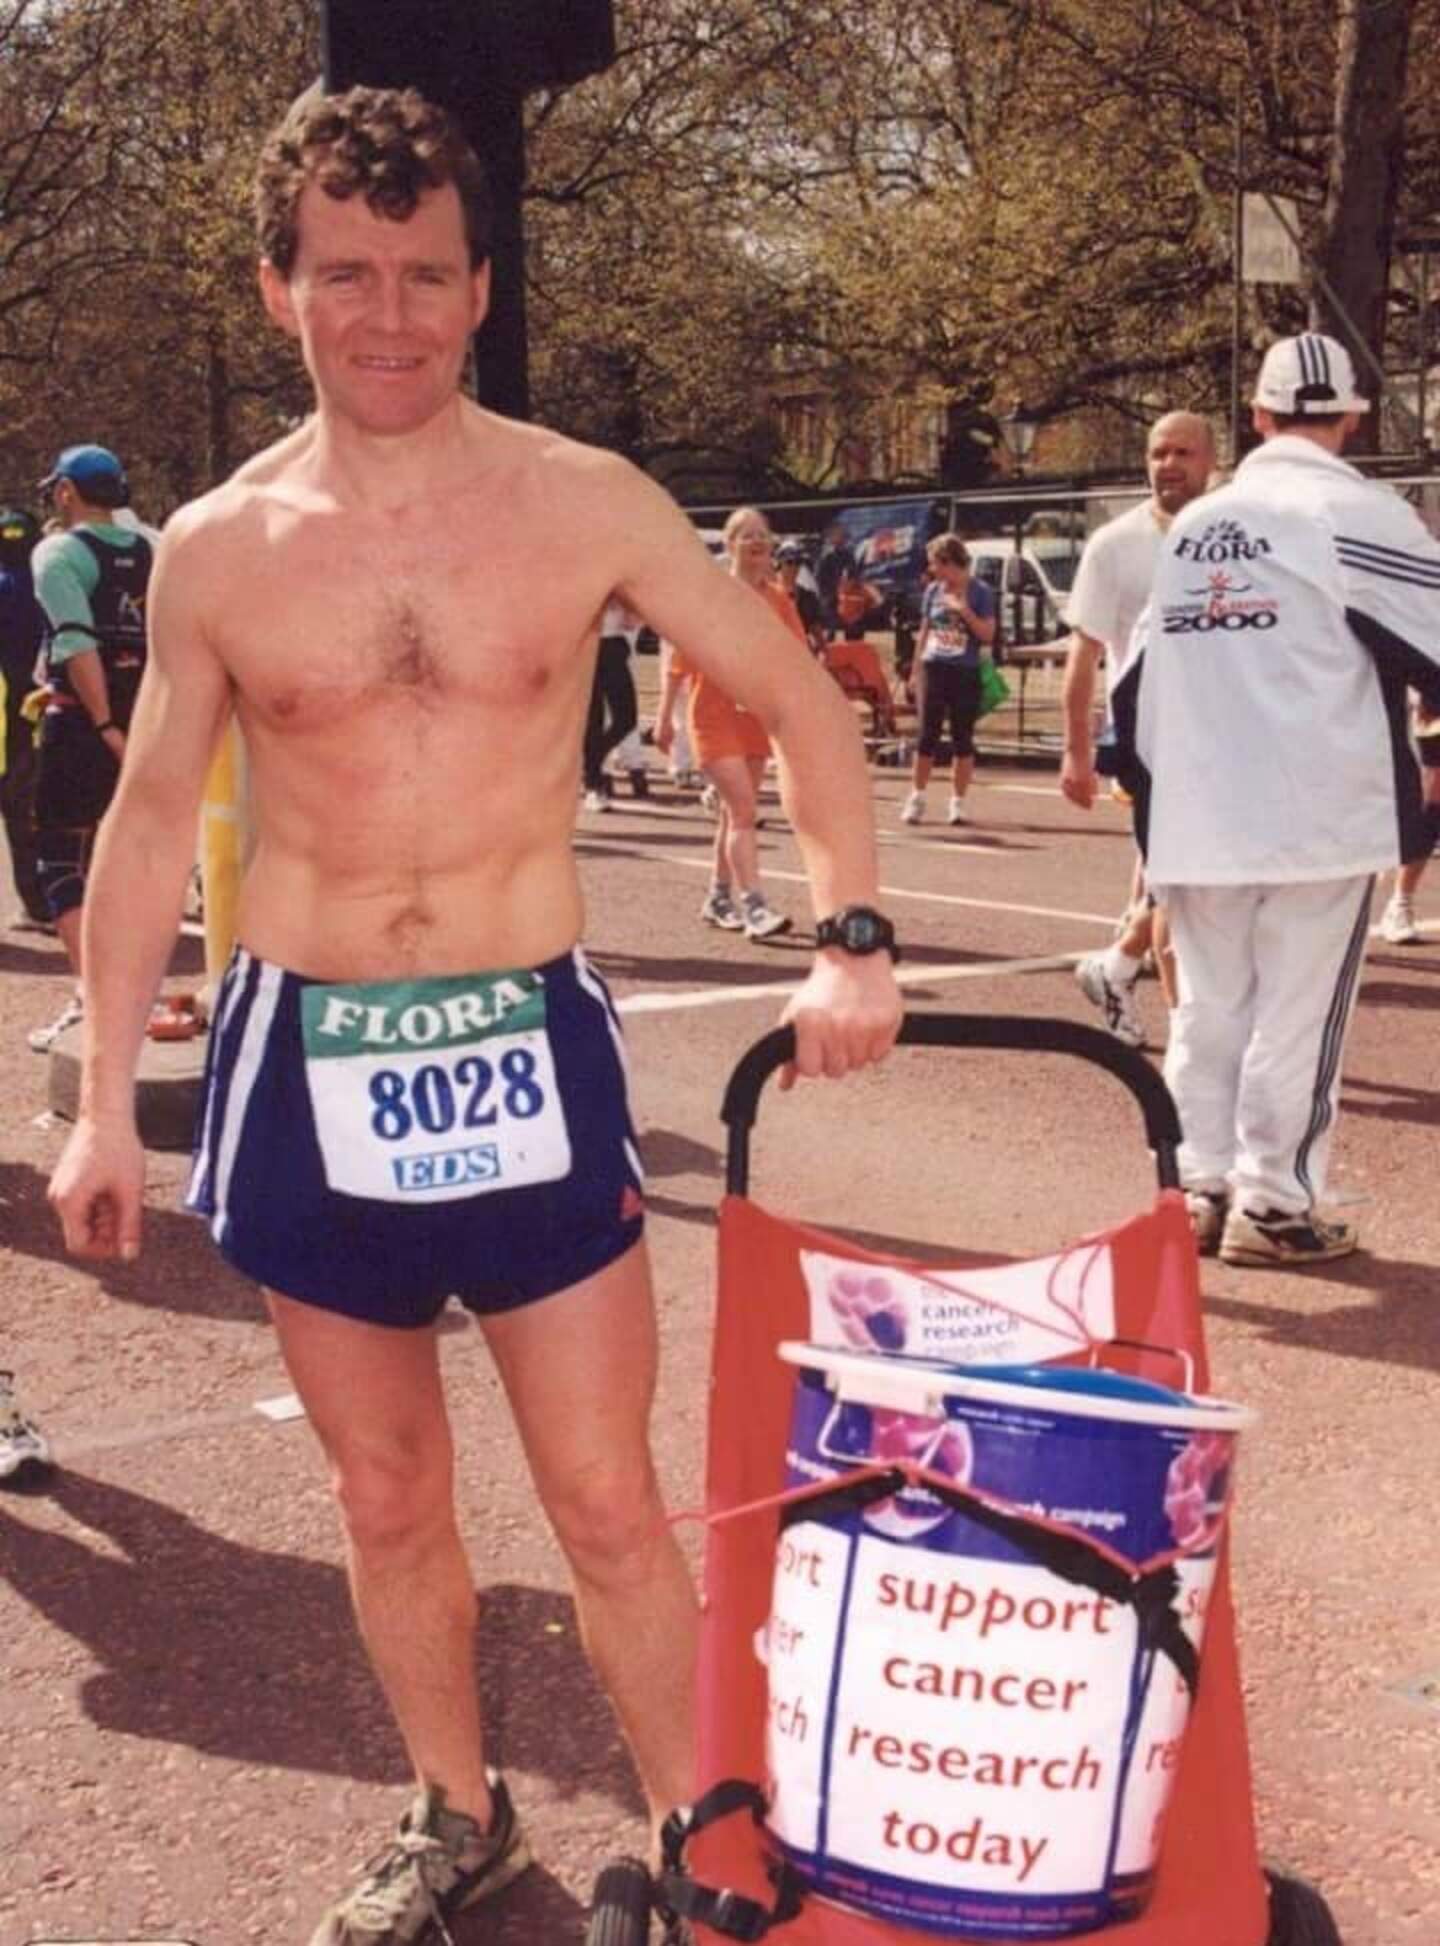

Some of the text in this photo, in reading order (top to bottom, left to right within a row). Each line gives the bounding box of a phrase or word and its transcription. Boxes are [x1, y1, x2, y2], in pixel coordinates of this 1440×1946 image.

[1173, 537, 1271, 563] FLORA
[1162, 611, 1279, 634] 2000
[316, 978, 532, 1044] FLORA
[369, 1048, 544, 1141] 8028
[396, 1144, 500, 1189] EDS
[921, 1303, 994, 1320] cancer
[921, 1311, 1020, 1339] research
[878, 1572, 1114, 1638] support
[882, 1656, 1088, 1712] cancer
[848, 1724, 1101, 1790] research
[882, 1810, 1048, 1882] today
